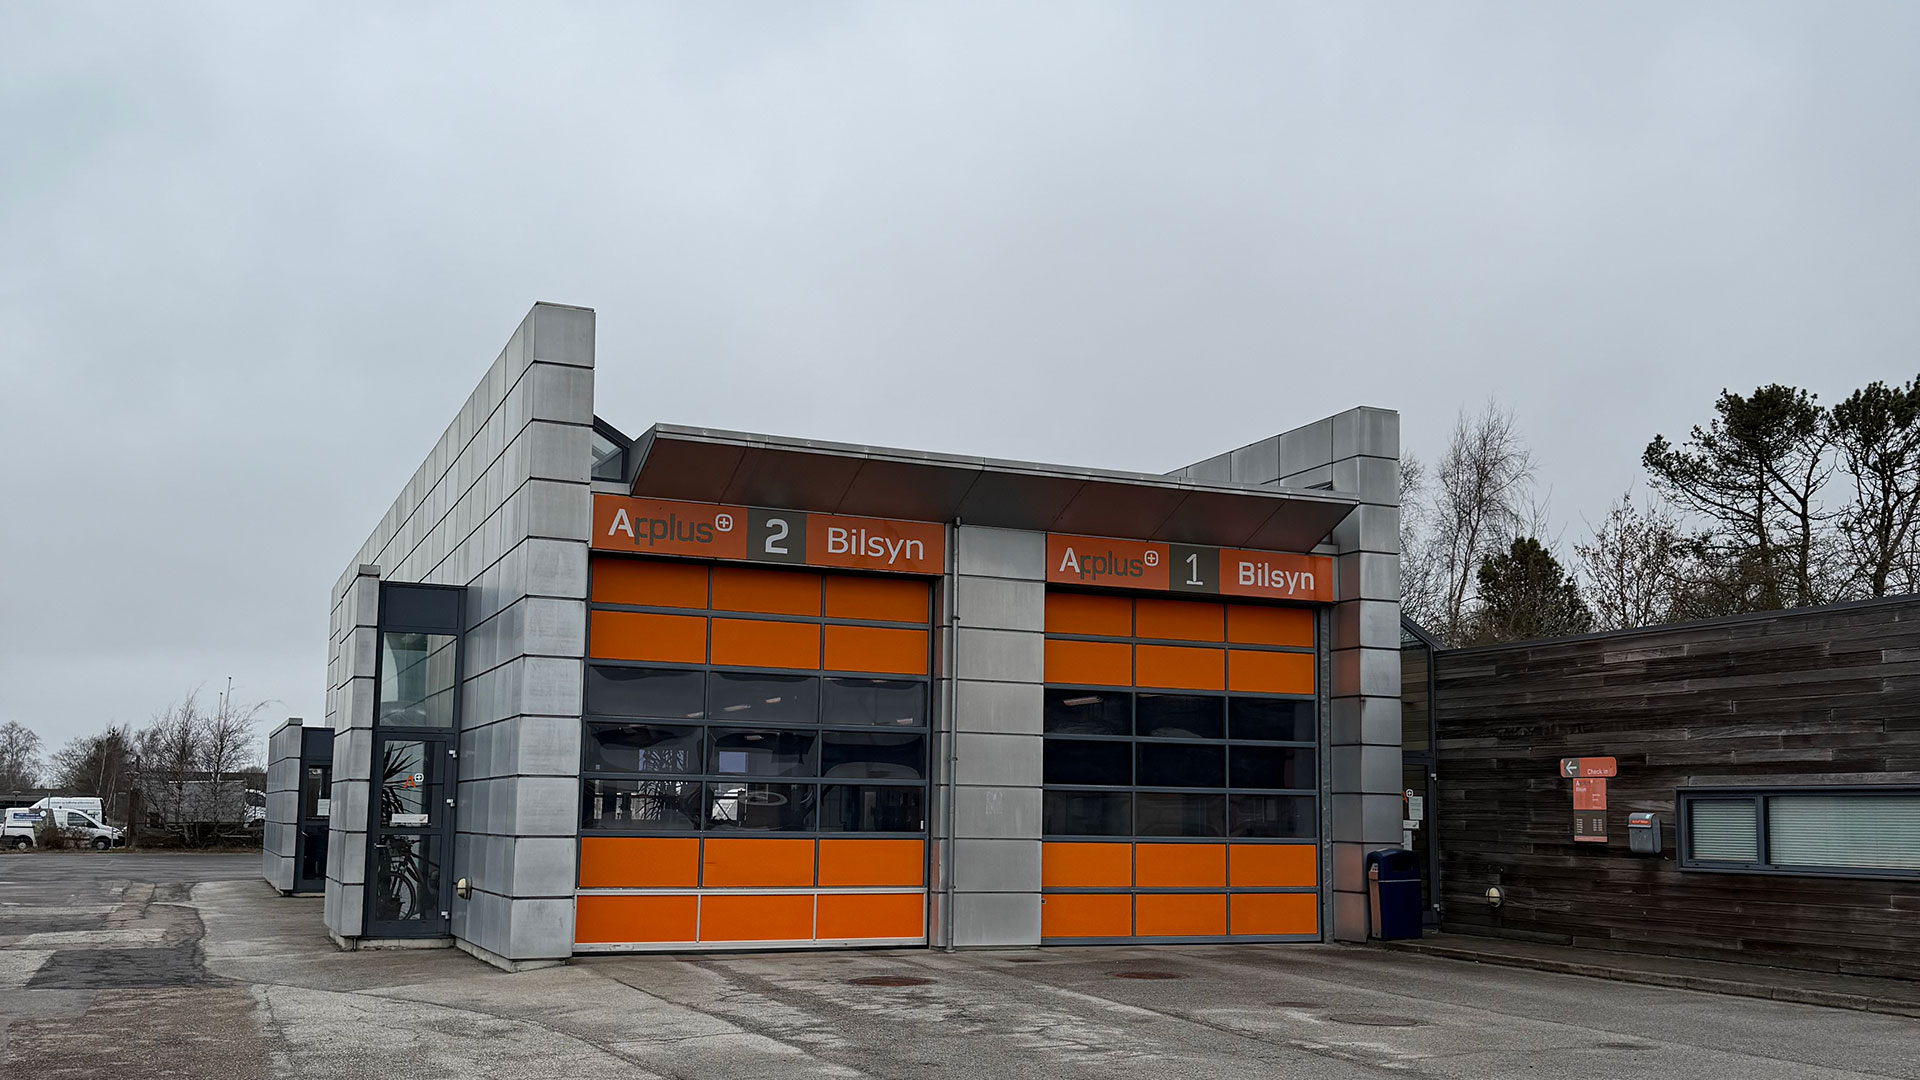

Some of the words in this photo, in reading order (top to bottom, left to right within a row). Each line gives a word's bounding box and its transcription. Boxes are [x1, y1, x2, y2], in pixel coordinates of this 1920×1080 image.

[608, 508, 714, 546] Applus
[765, 518, 789, 554] 2
[827, 526, 924, 565] Bilsyn
[1059, 547, 1144, 581] Applus
[1186, 553, 1203, 586] 1
[1239, 561, 1315, 595] Bilsyn
